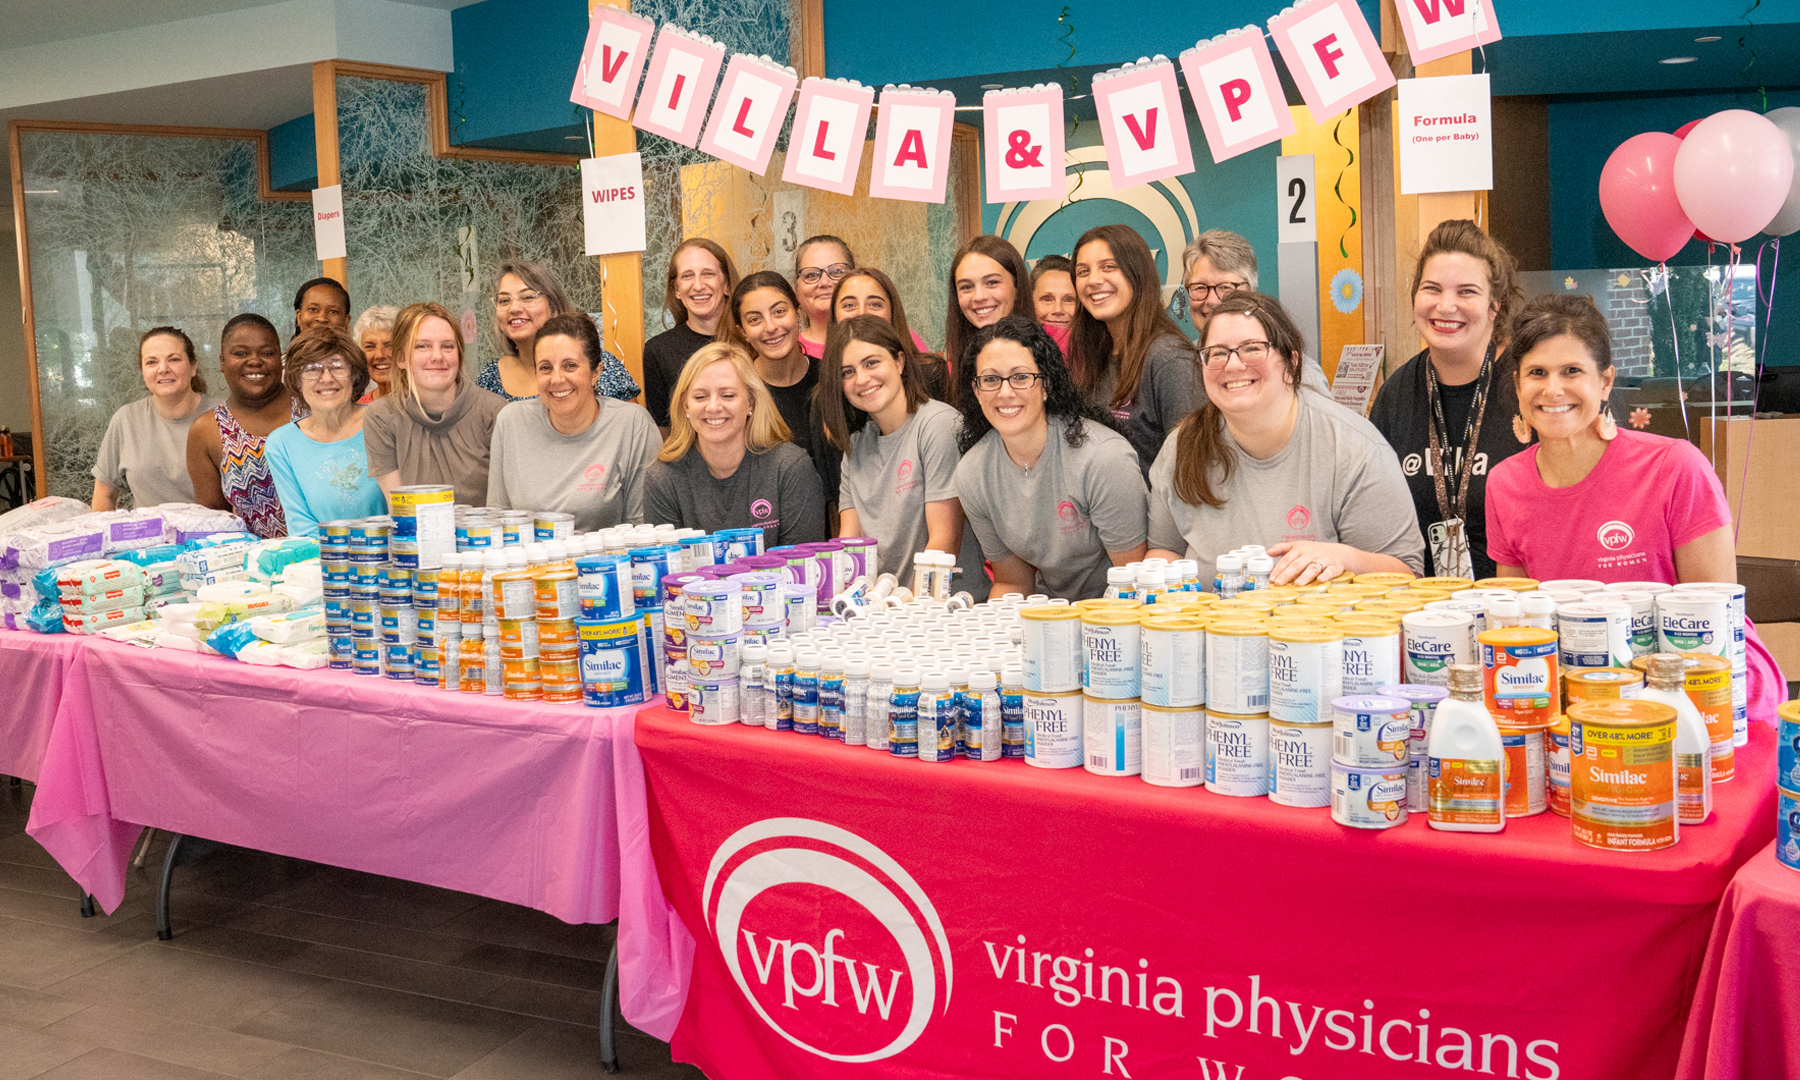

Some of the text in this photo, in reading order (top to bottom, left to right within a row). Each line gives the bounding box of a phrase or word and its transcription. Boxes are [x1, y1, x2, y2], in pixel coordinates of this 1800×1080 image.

[1413, 112, 1477, 127] Formula
[1412, 135, 1434, 144] (One
[1453, 132, 1479, 141] Baby)
[1003, 129, 1045, 170] &
[591, 186, 636, 204] WIPES
[1286, 177, 1307, 224] 2
[317, 211, 340, 221] Diapers
[781, 210, 797, 252] 3
[1603, 532, 1628, 546] vpfw
[1663, 616, 1710, 629] EleCare
[1082, 636, 1122, 651] HENYL-
[1407, 637, 1452, 652] EleCare
[1090, 650, 1122, 662] FREE
[585, 660, 622, 671] Similac
[1501, 672, 1544, 685] Similac
[1036, 721, 1068, 733] FREE
[1025, 727, 1032, 744] 2
[1587, 730, 1608, 739] OVER
[1609, 732, 1625, 740] 48%
[1217, 743, 1252, 758] FREE
[1279, 753, 1313, 768] FREE
[1589, 765, 1648, 785] Similac
[1591, 795, 1618, 804] SENSITIVE
[1607, 837, 1628, 846] INFANT
[1629, 838, 1656, 847] FORMULA
[741, 928, 904, 1022] vpfw
[983, 934, 1561, 1080] virginia physicians
[992, 1010, 1133, 1080] FOR
